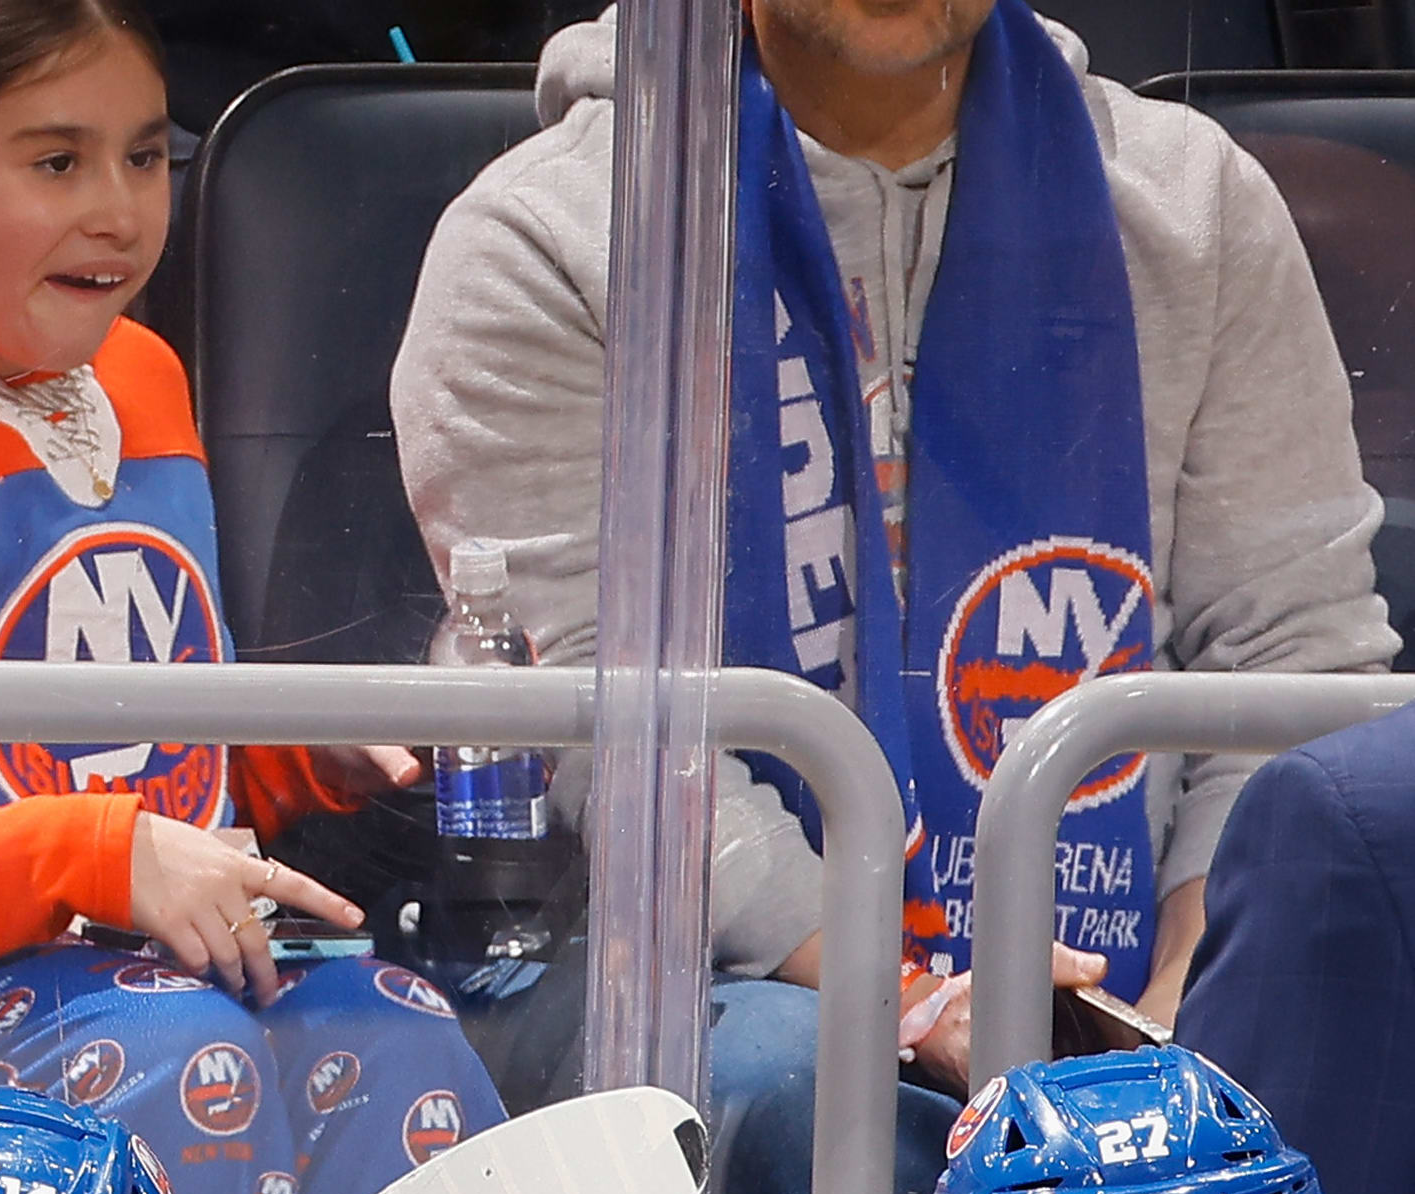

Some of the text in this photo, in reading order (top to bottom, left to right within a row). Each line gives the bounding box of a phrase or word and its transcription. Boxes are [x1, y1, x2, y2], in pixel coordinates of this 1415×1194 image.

[997, 568, 1144, 682] NY
[931, 835, 1133, 896] UB RENA
[1080, 907, 1140, 949] PARK
[1095, 1115, 1170, 1165] 27
